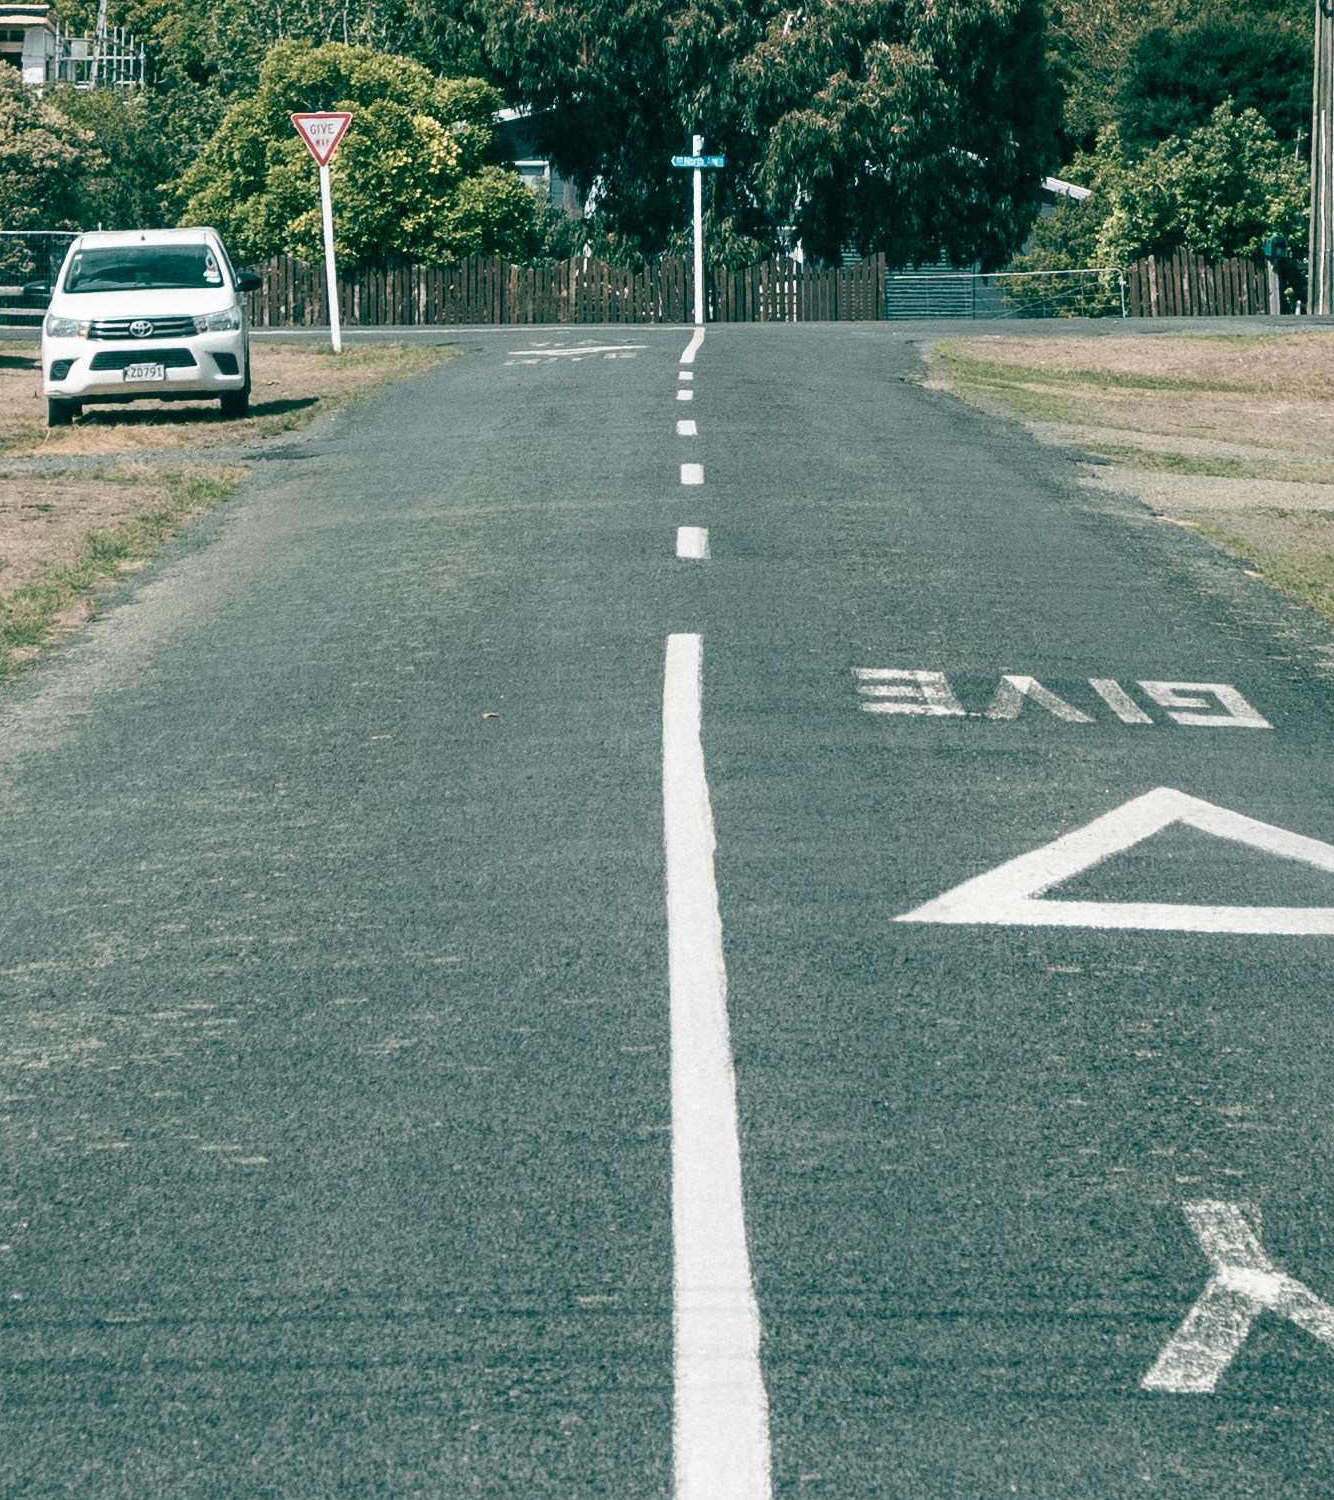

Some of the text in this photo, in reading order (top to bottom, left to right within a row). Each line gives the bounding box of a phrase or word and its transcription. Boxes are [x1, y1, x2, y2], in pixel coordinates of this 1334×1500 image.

[310, 123, 334, 135] GIVE
[315, 138, 330, 147] WAY
[851, 666, 1275, 730] GIVE
